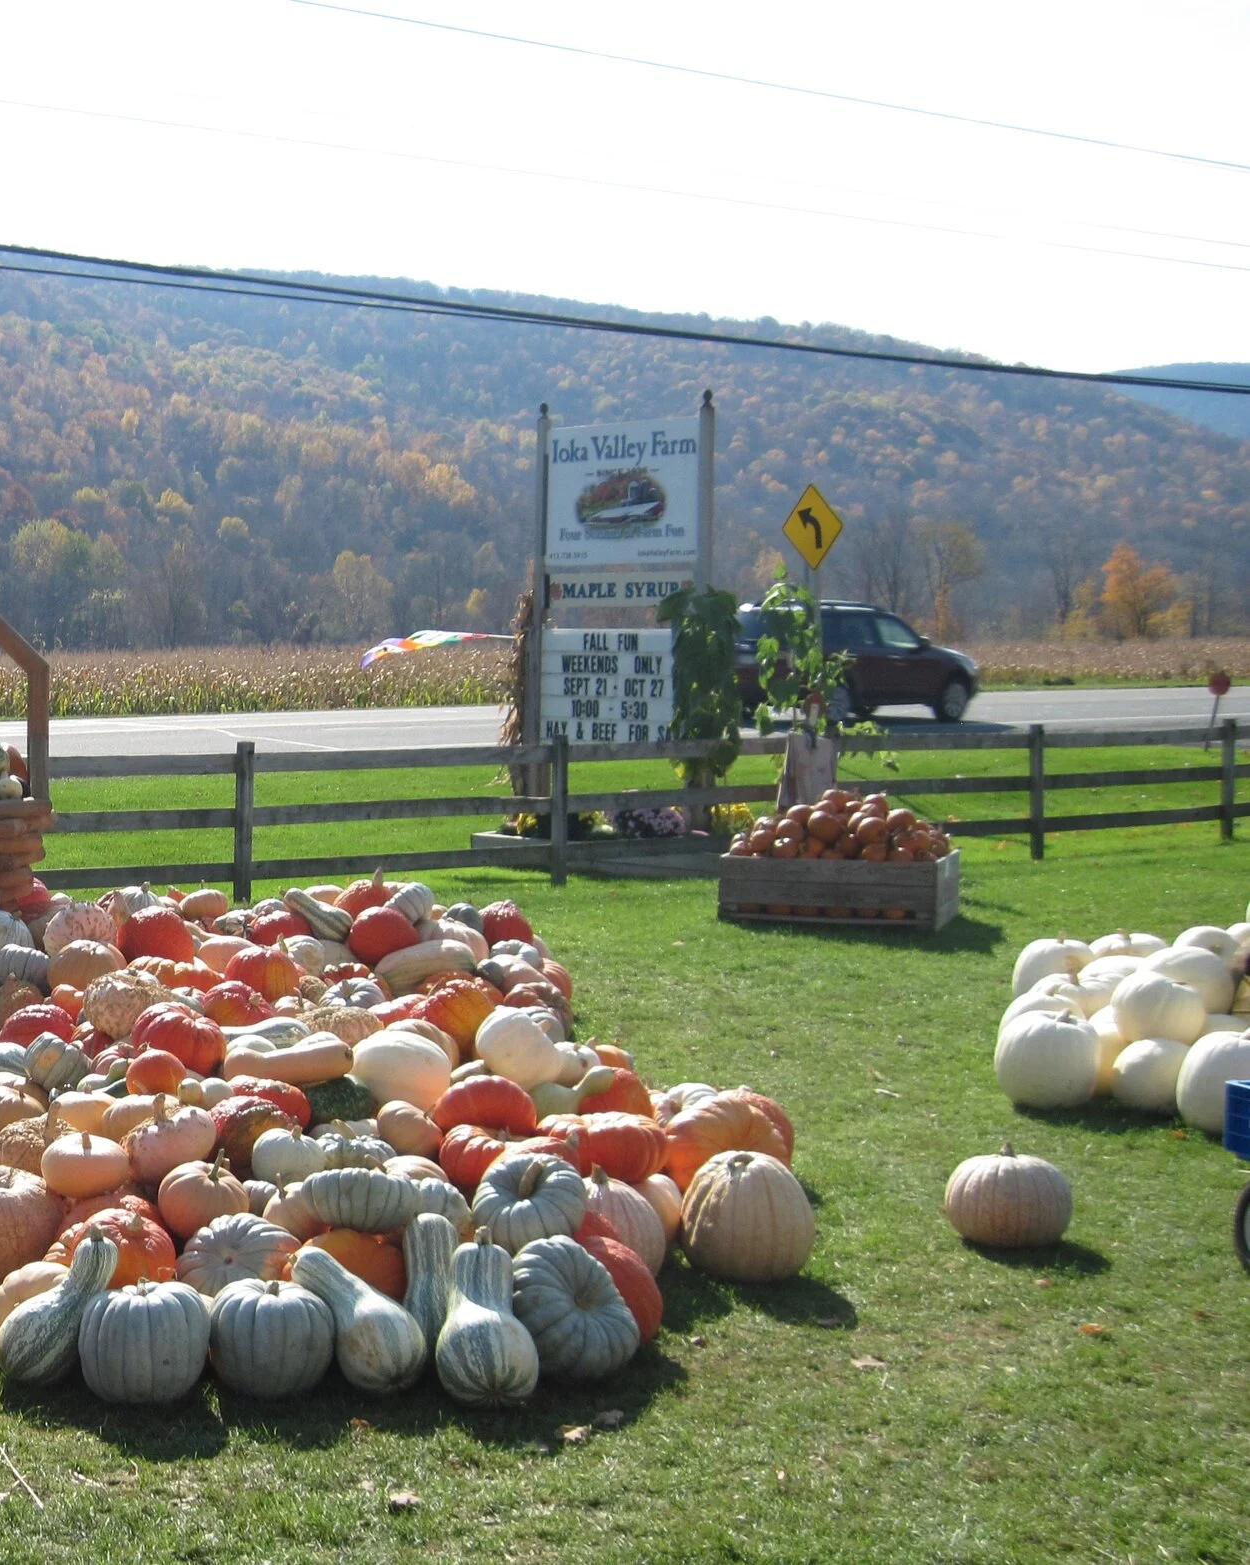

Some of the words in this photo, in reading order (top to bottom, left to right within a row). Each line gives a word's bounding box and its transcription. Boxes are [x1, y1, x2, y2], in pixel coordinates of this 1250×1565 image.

[552, 439, 588, 463] Ioka
[591, 434, 647, 465] Valley
[651, 431, 696, 456] Farm
[665, 524, 685, 537] Fun
[562, 582, 616, 599] MAPLE
[624, 581, 680, 598] SYRUP
[583, 633, 609, 651] FALL
[617, 633, 639, 651] FUN
[562, 655, 618, 674] WEEKENDS
[634, 655, 662, 675] ONLY
[563, 677, 590, 696] SEPT
[596, 677, 607, 696] 21
[624, 679, 646, 697] OCT
[650, 679, 664, 697] 27
[572, 699, 599, 718] 10:00
[621, 701, 648, 719] 5:30
[546, 720, 568, 738] HAY
[576, 723, 584, 740] &
[592, 723, 618, 741] BEEF
[628, 724, 649, 742] FOR
